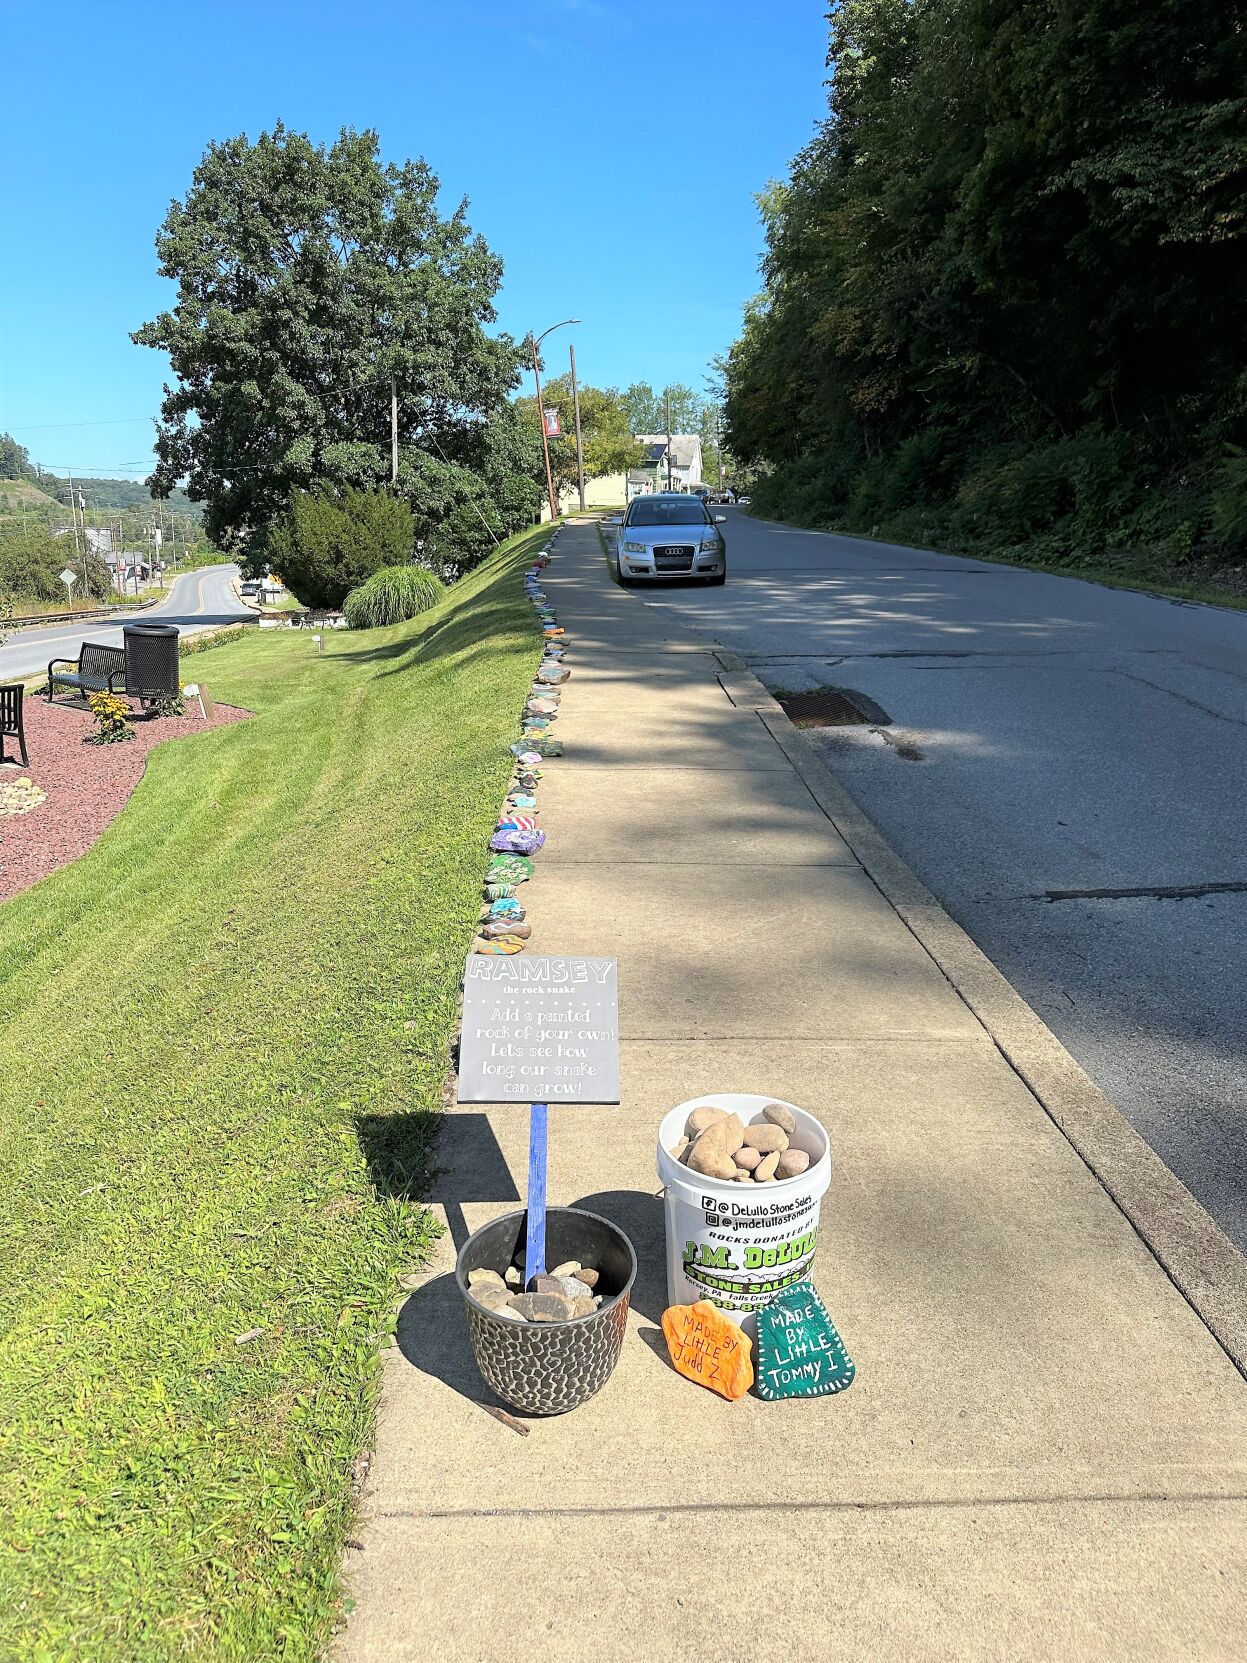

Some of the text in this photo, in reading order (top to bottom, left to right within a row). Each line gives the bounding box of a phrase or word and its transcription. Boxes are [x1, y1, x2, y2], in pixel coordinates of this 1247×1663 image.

[469, 956, 613, 984] RAMSEY
[503, 986, 576, 994] the rock snake
[491, 1008, 590, 1025] Add a painted
[476, 1026, 615, 1042] rock of your own!
[491, 1043, 588, 1057] Let's see how
[482, 1061, 597, 1079] long our snake
[504, 1083, 582, 1097] can grow!
[770, 1203, 794, 1214] Stone
[795, 1195, 812, 1208] Sales
[709, 1231, 751, 1244] ROCKS
[753, 1226, 804, 1244] DONATED
[682, 1241, 739, 1270] J.M.
[686, 1265, 744, 1293] STONE
[712, 1289, 722, 1297] PA
[729, 1293, 749, 1301] Falls
[750, 1293, 773, 1302] Creek
[771, 1305, 814, 1329] MADE
[683, 1315, 738, 1353] MADE BY
[786, 1326, 804, 1344] BY
[674, 1342, 720, 1381] Judd Z
[767, 1351, 838, 1387] TOMMY I
